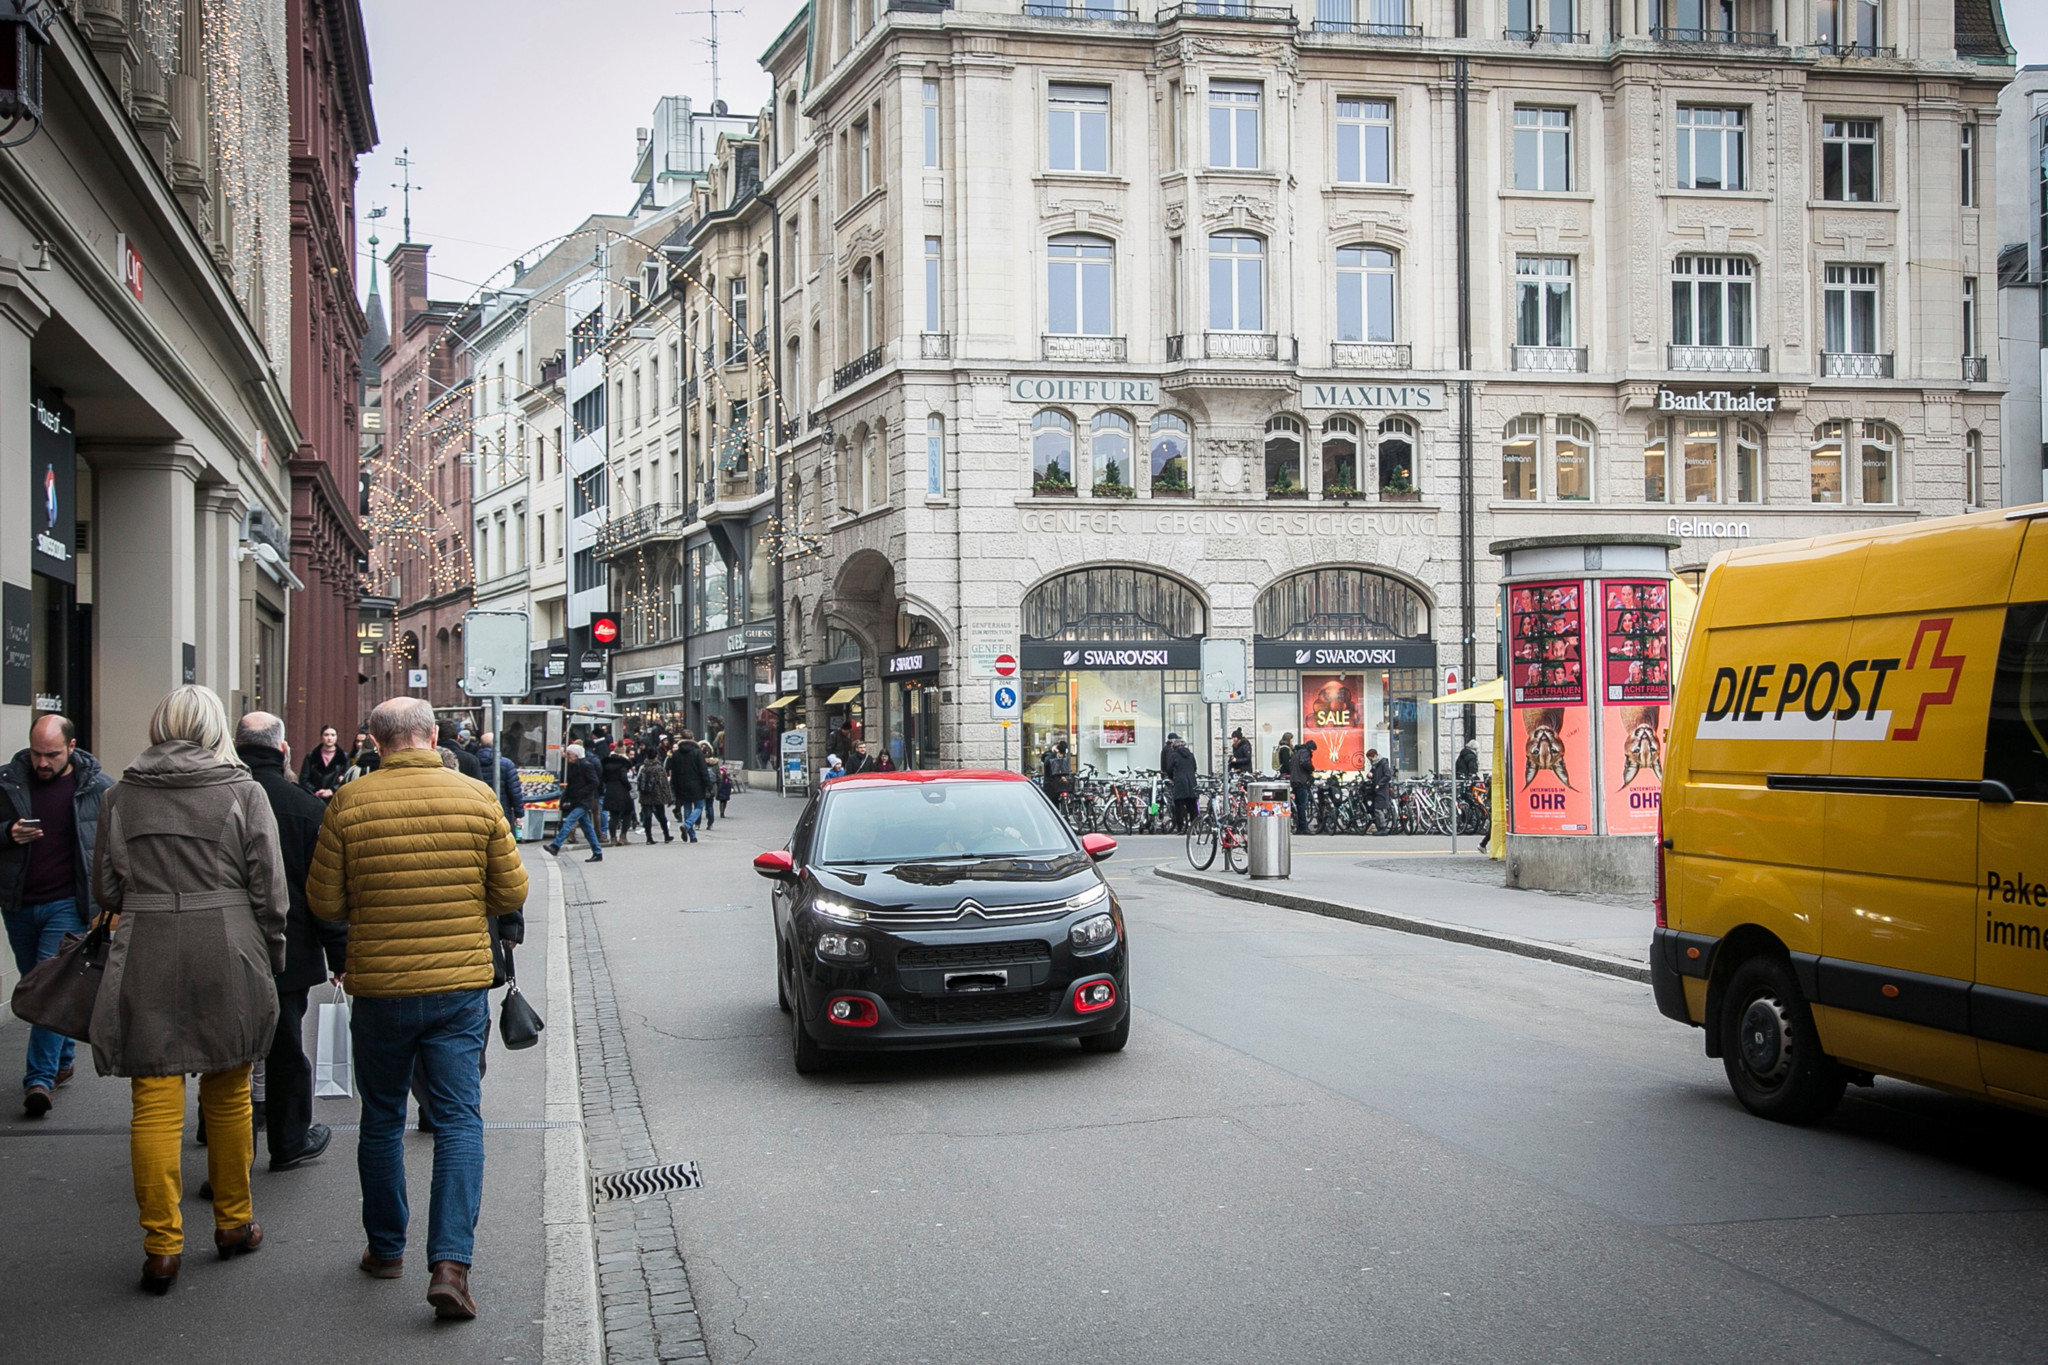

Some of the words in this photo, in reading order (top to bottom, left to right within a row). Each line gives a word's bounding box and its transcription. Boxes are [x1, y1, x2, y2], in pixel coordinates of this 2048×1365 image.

[127, 249, 142, 291] CIC
[1016, 379, 1154, 401] COIFFURE
[1314, 386, 1431, 407] MAXIM'S
[1658, 389, 1776, 411] BankThaler
[1021, 510, 1127, 534] GENFER
[1141, 511, 1436, 537] LEBENSVERSICHERUNG
[1667, 516, 1750, 538] fielmann
[1084, 650, 1168, 665] SWAROVSKI
[1315, 649, 1396, 664] SWAROVSKI
[1545, 686, 1581, 694] FRAUEN
[1705, 664, 1776, 721] DIE
[1774, 658, 1901, 721] POST
[1104, 699, 1138, 713] SALE
[1317, 711, 1350, 725] SALE
[1530, 794, 1565, 809] OHR
[1987, 871, 2048, 907] Pake
